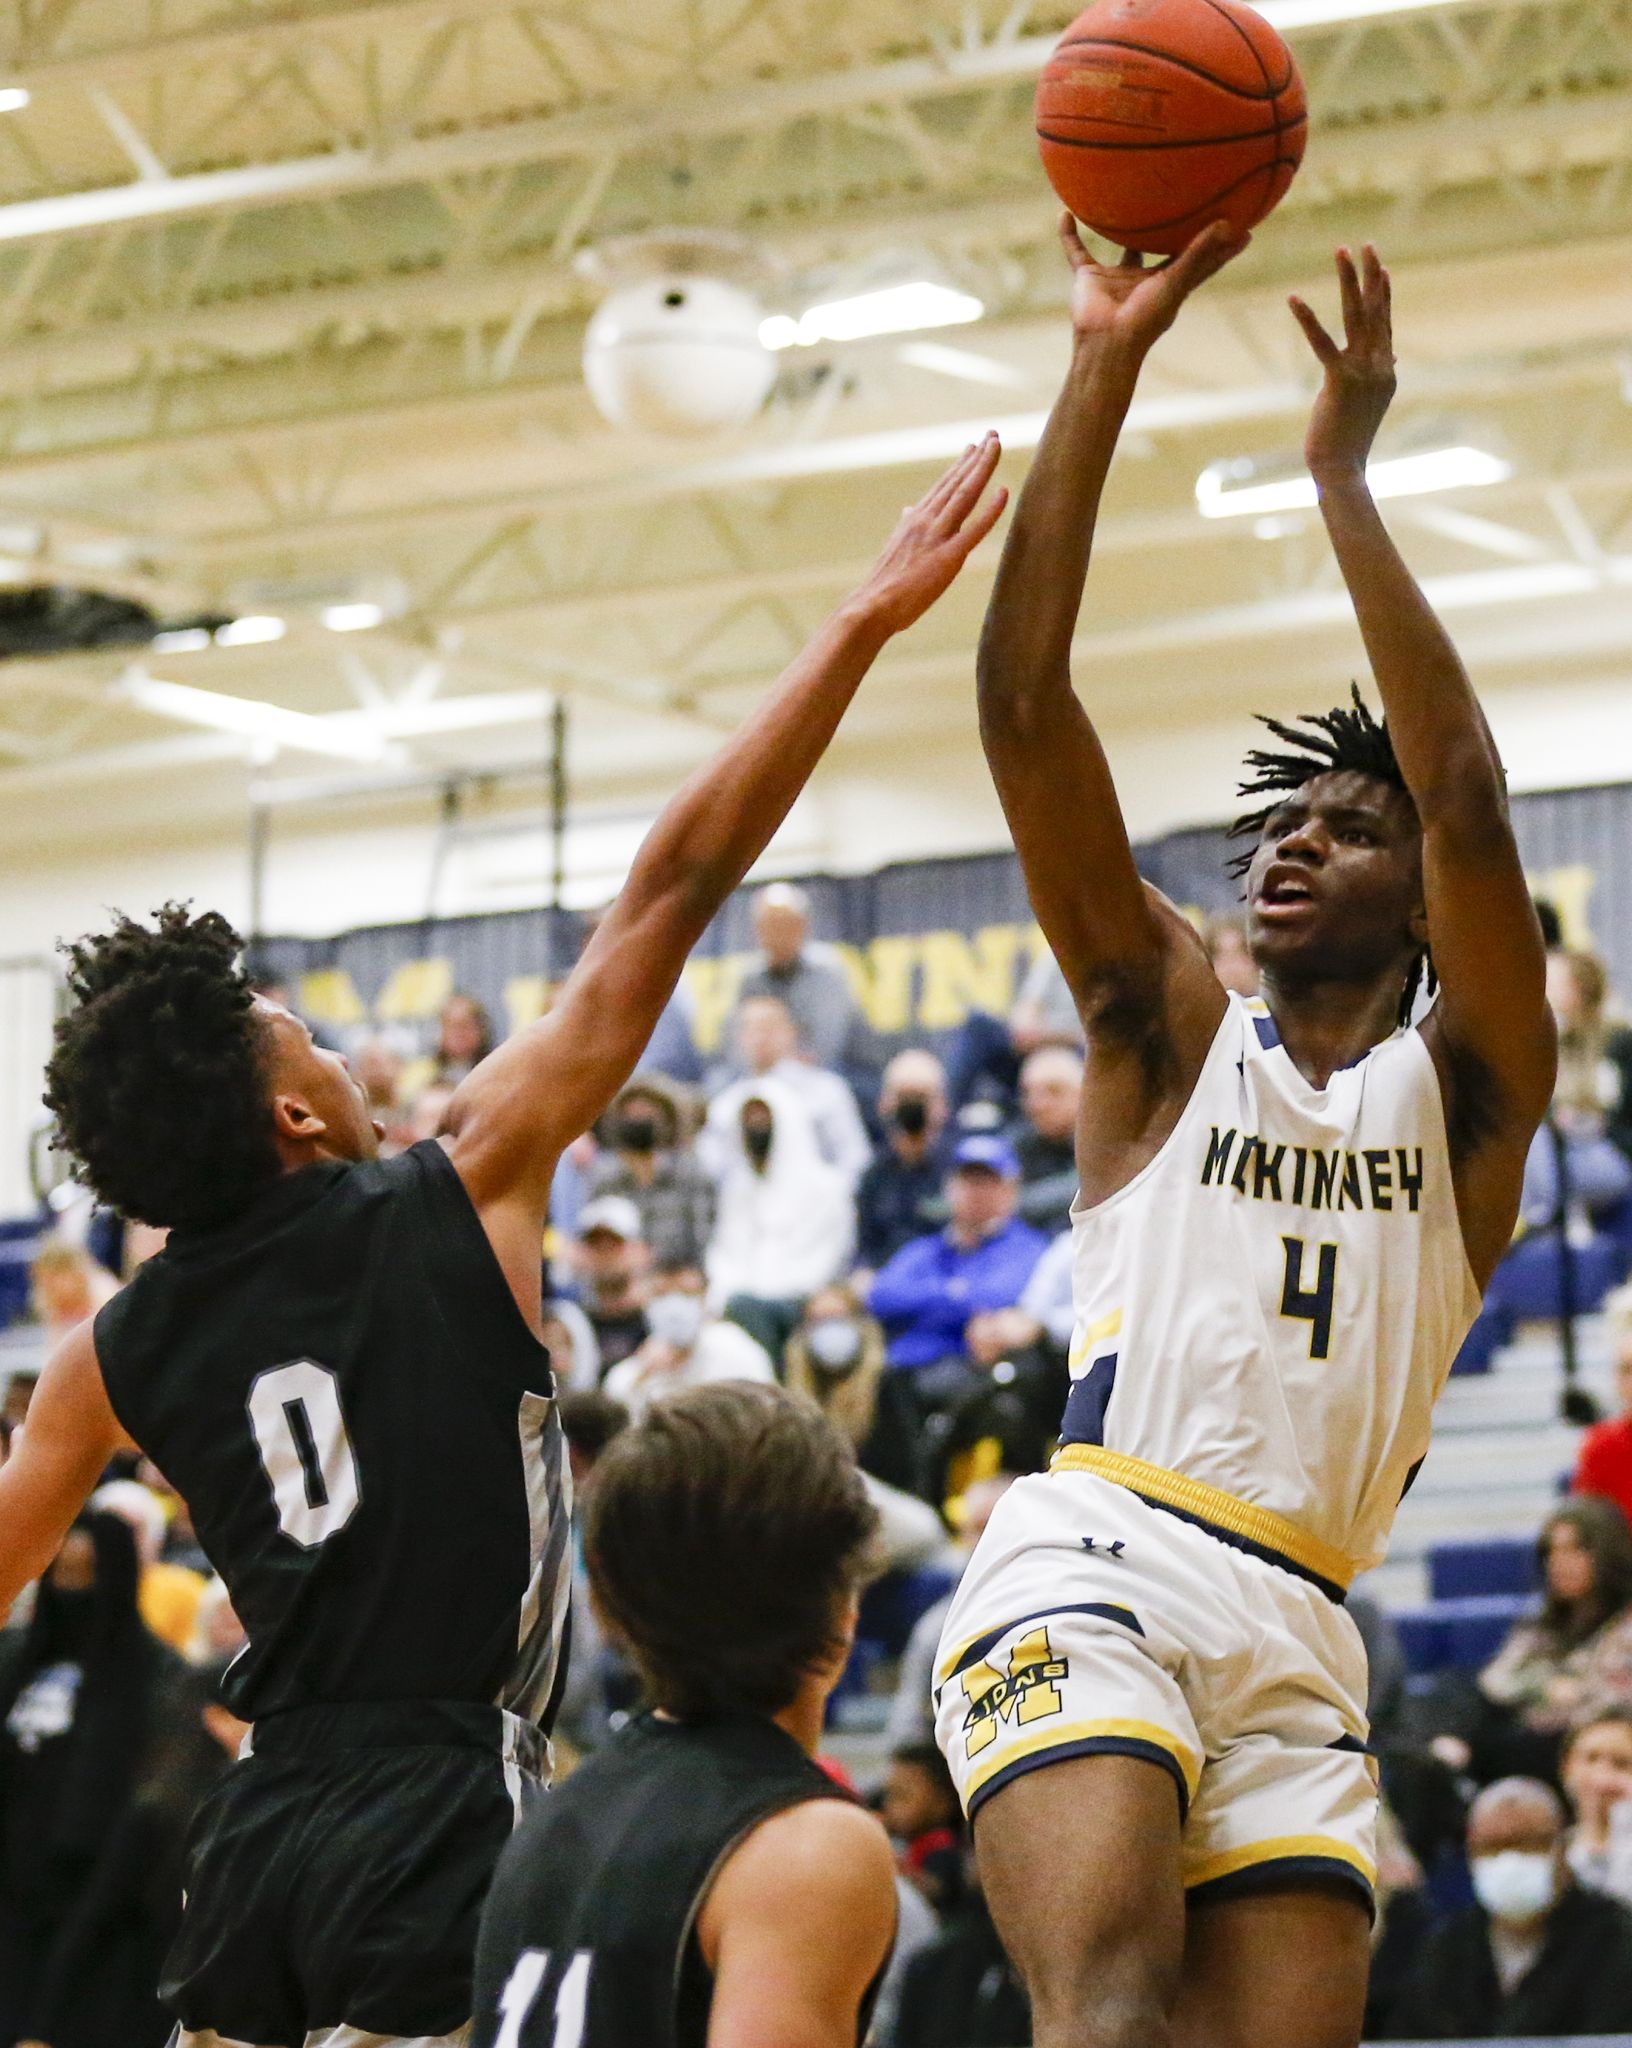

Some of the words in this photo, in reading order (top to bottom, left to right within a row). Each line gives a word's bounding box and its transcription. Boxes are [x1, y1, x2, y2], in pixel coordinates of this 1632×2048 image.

[1199, 1125, 1424, 1213] MCKINNEY
[1279, 1235, 1339, 1361] 4
[245, 1357, 363, 1551] 0
[965, 1663, 1066, 1727] LIONS
